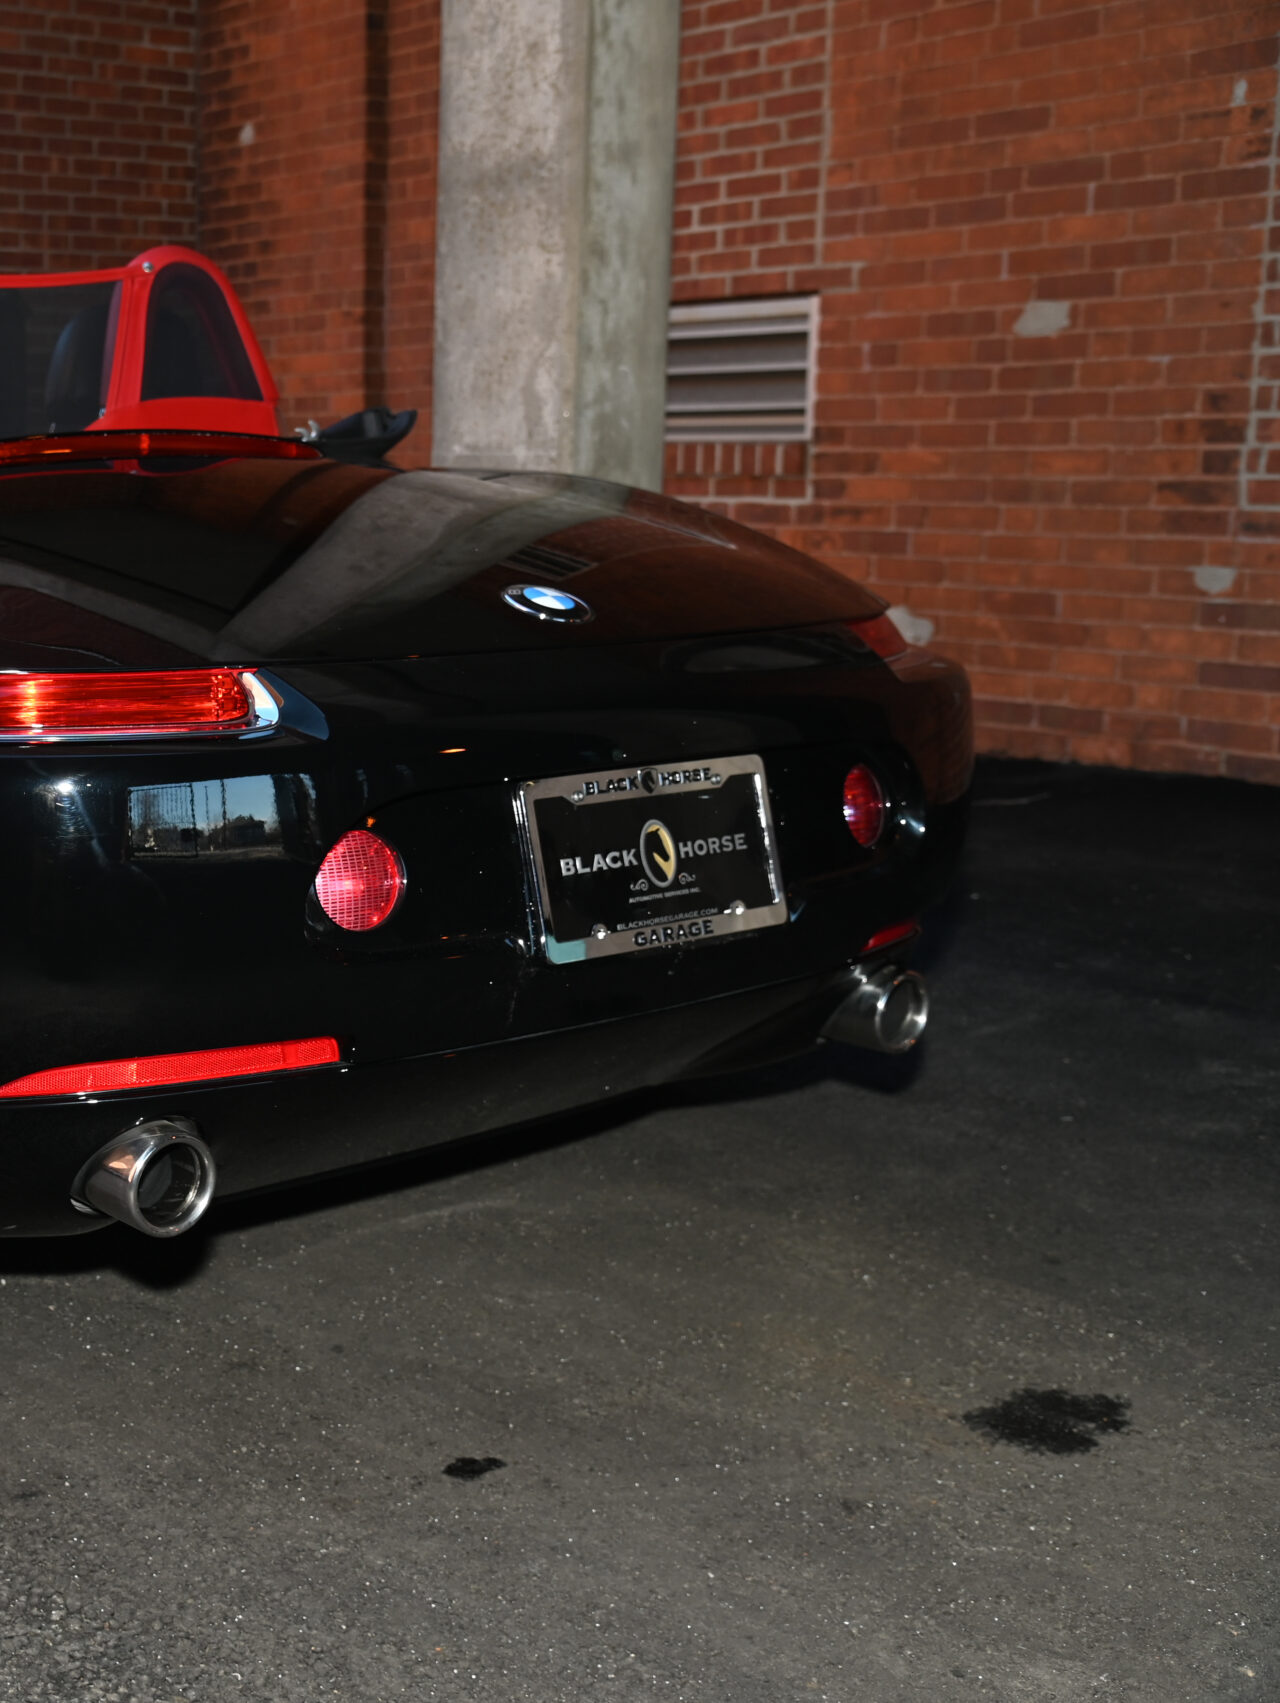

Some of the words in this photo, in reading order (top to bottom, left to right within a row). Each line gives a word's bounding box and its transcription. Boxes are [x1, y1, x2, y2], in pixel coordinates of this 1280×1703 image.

[583, 776, 638, 795] BLACK
[659, 768, 711, 786] HORSE
[560, 849, 638, 876] BLACK
[679, 834, 747, 858] HORSE
[618, 909, 717, 930] BLACKHORSEGARAGE.COM
[634, 920, 714, 945] GARAGE
